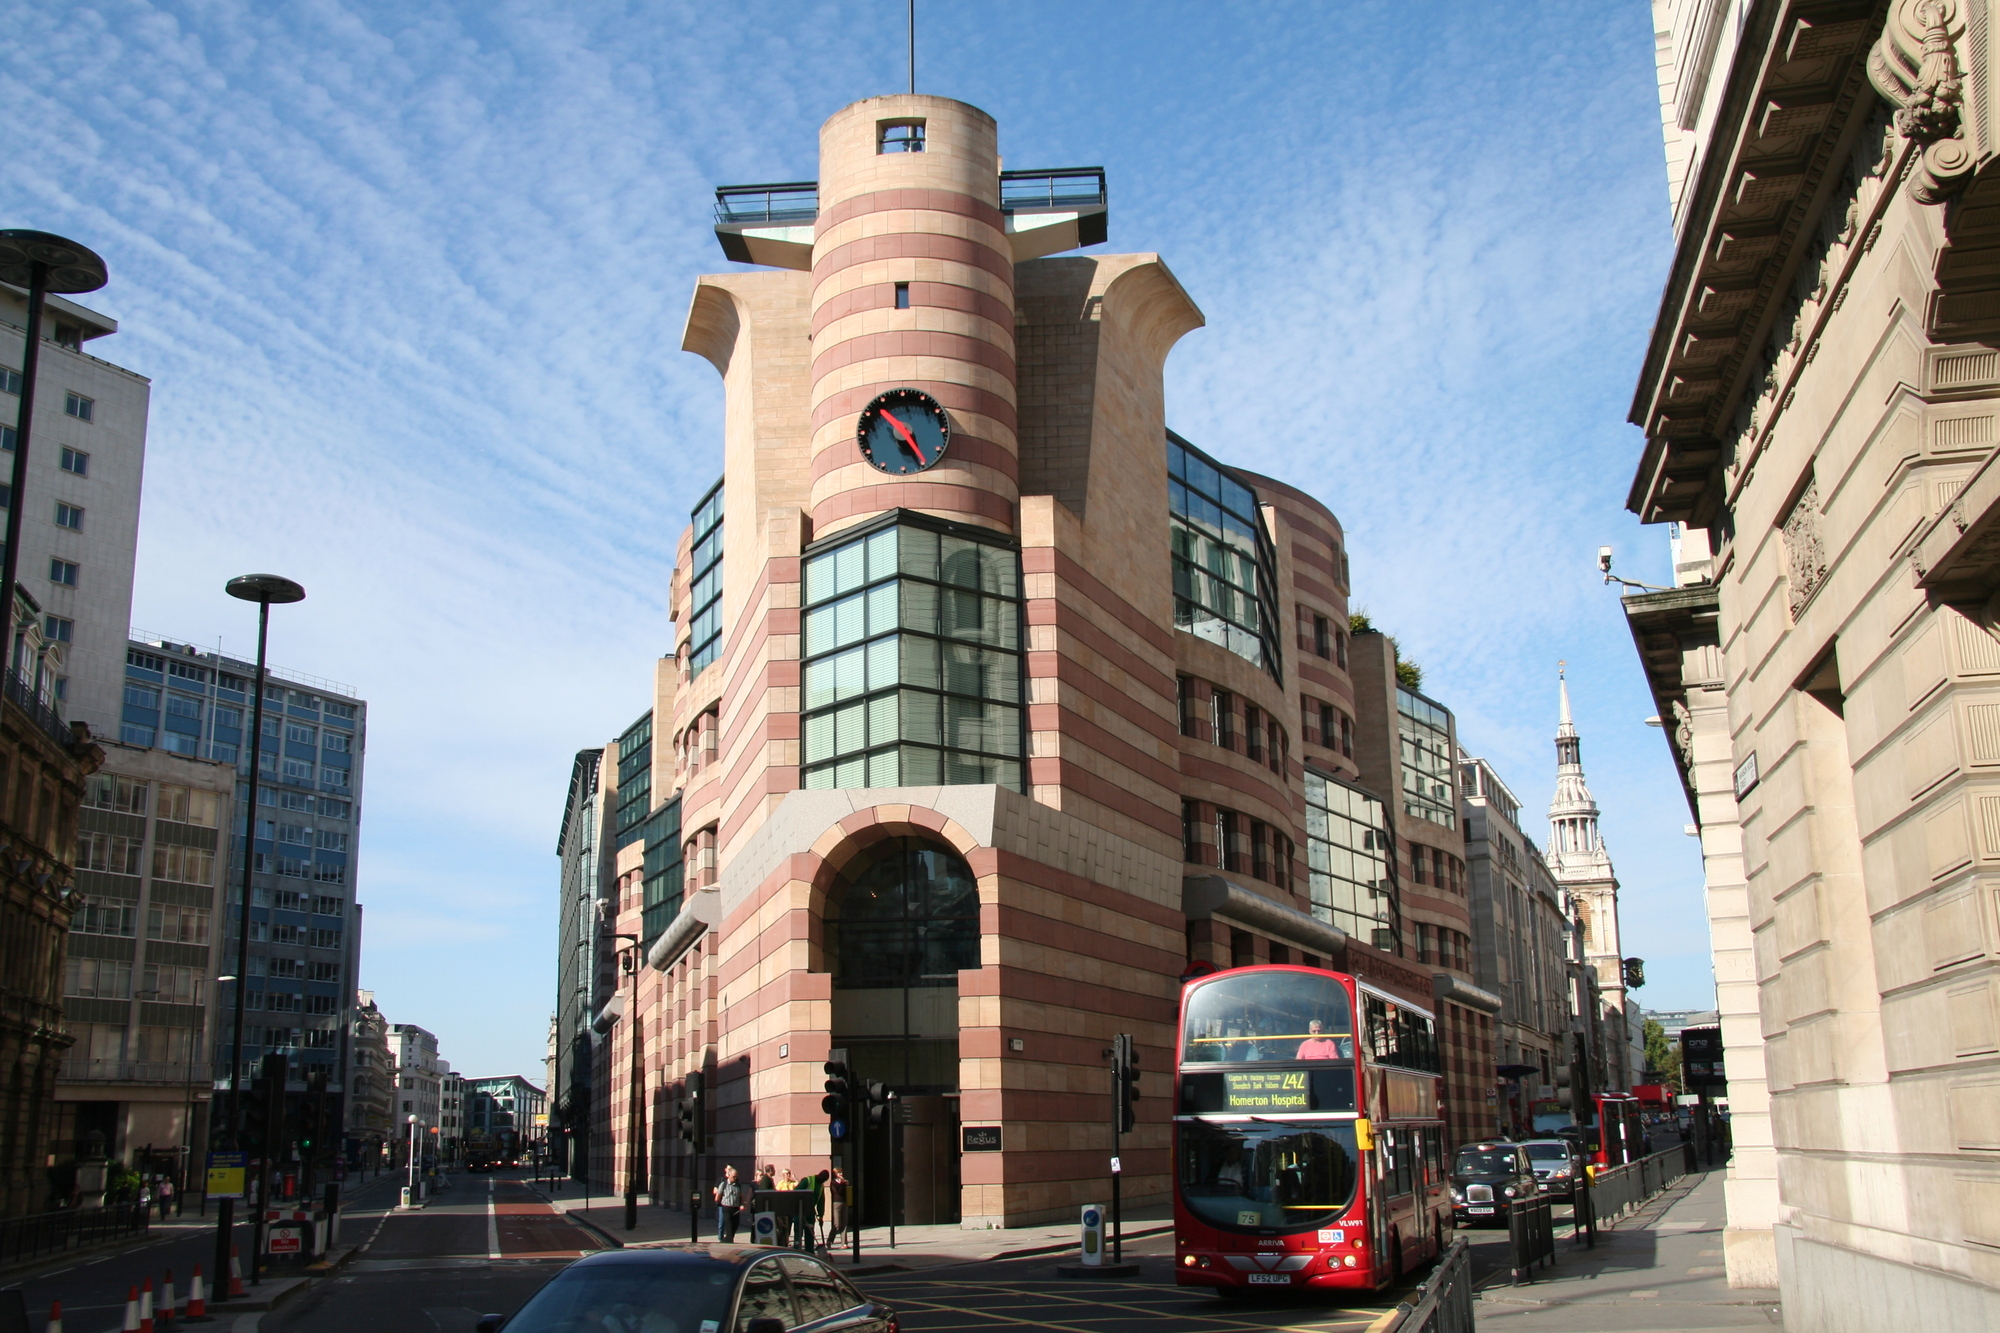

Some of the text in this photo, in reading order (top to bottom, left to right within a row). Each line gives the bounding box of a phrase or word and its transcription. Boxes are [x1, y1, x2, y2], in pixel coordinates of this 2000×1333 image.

[1282, 1073, 1305, 1089] 242
[1229, 1093, 1306, 1108] Homerton Hospital
[967, 1135, 996, 1145] Regus
[1242, 1214, 1255, 1224] 75
[1258, 1239, 1285, 1247] ARRIVA
[1251, 1274, 1288, 1282] LF52 UPG
